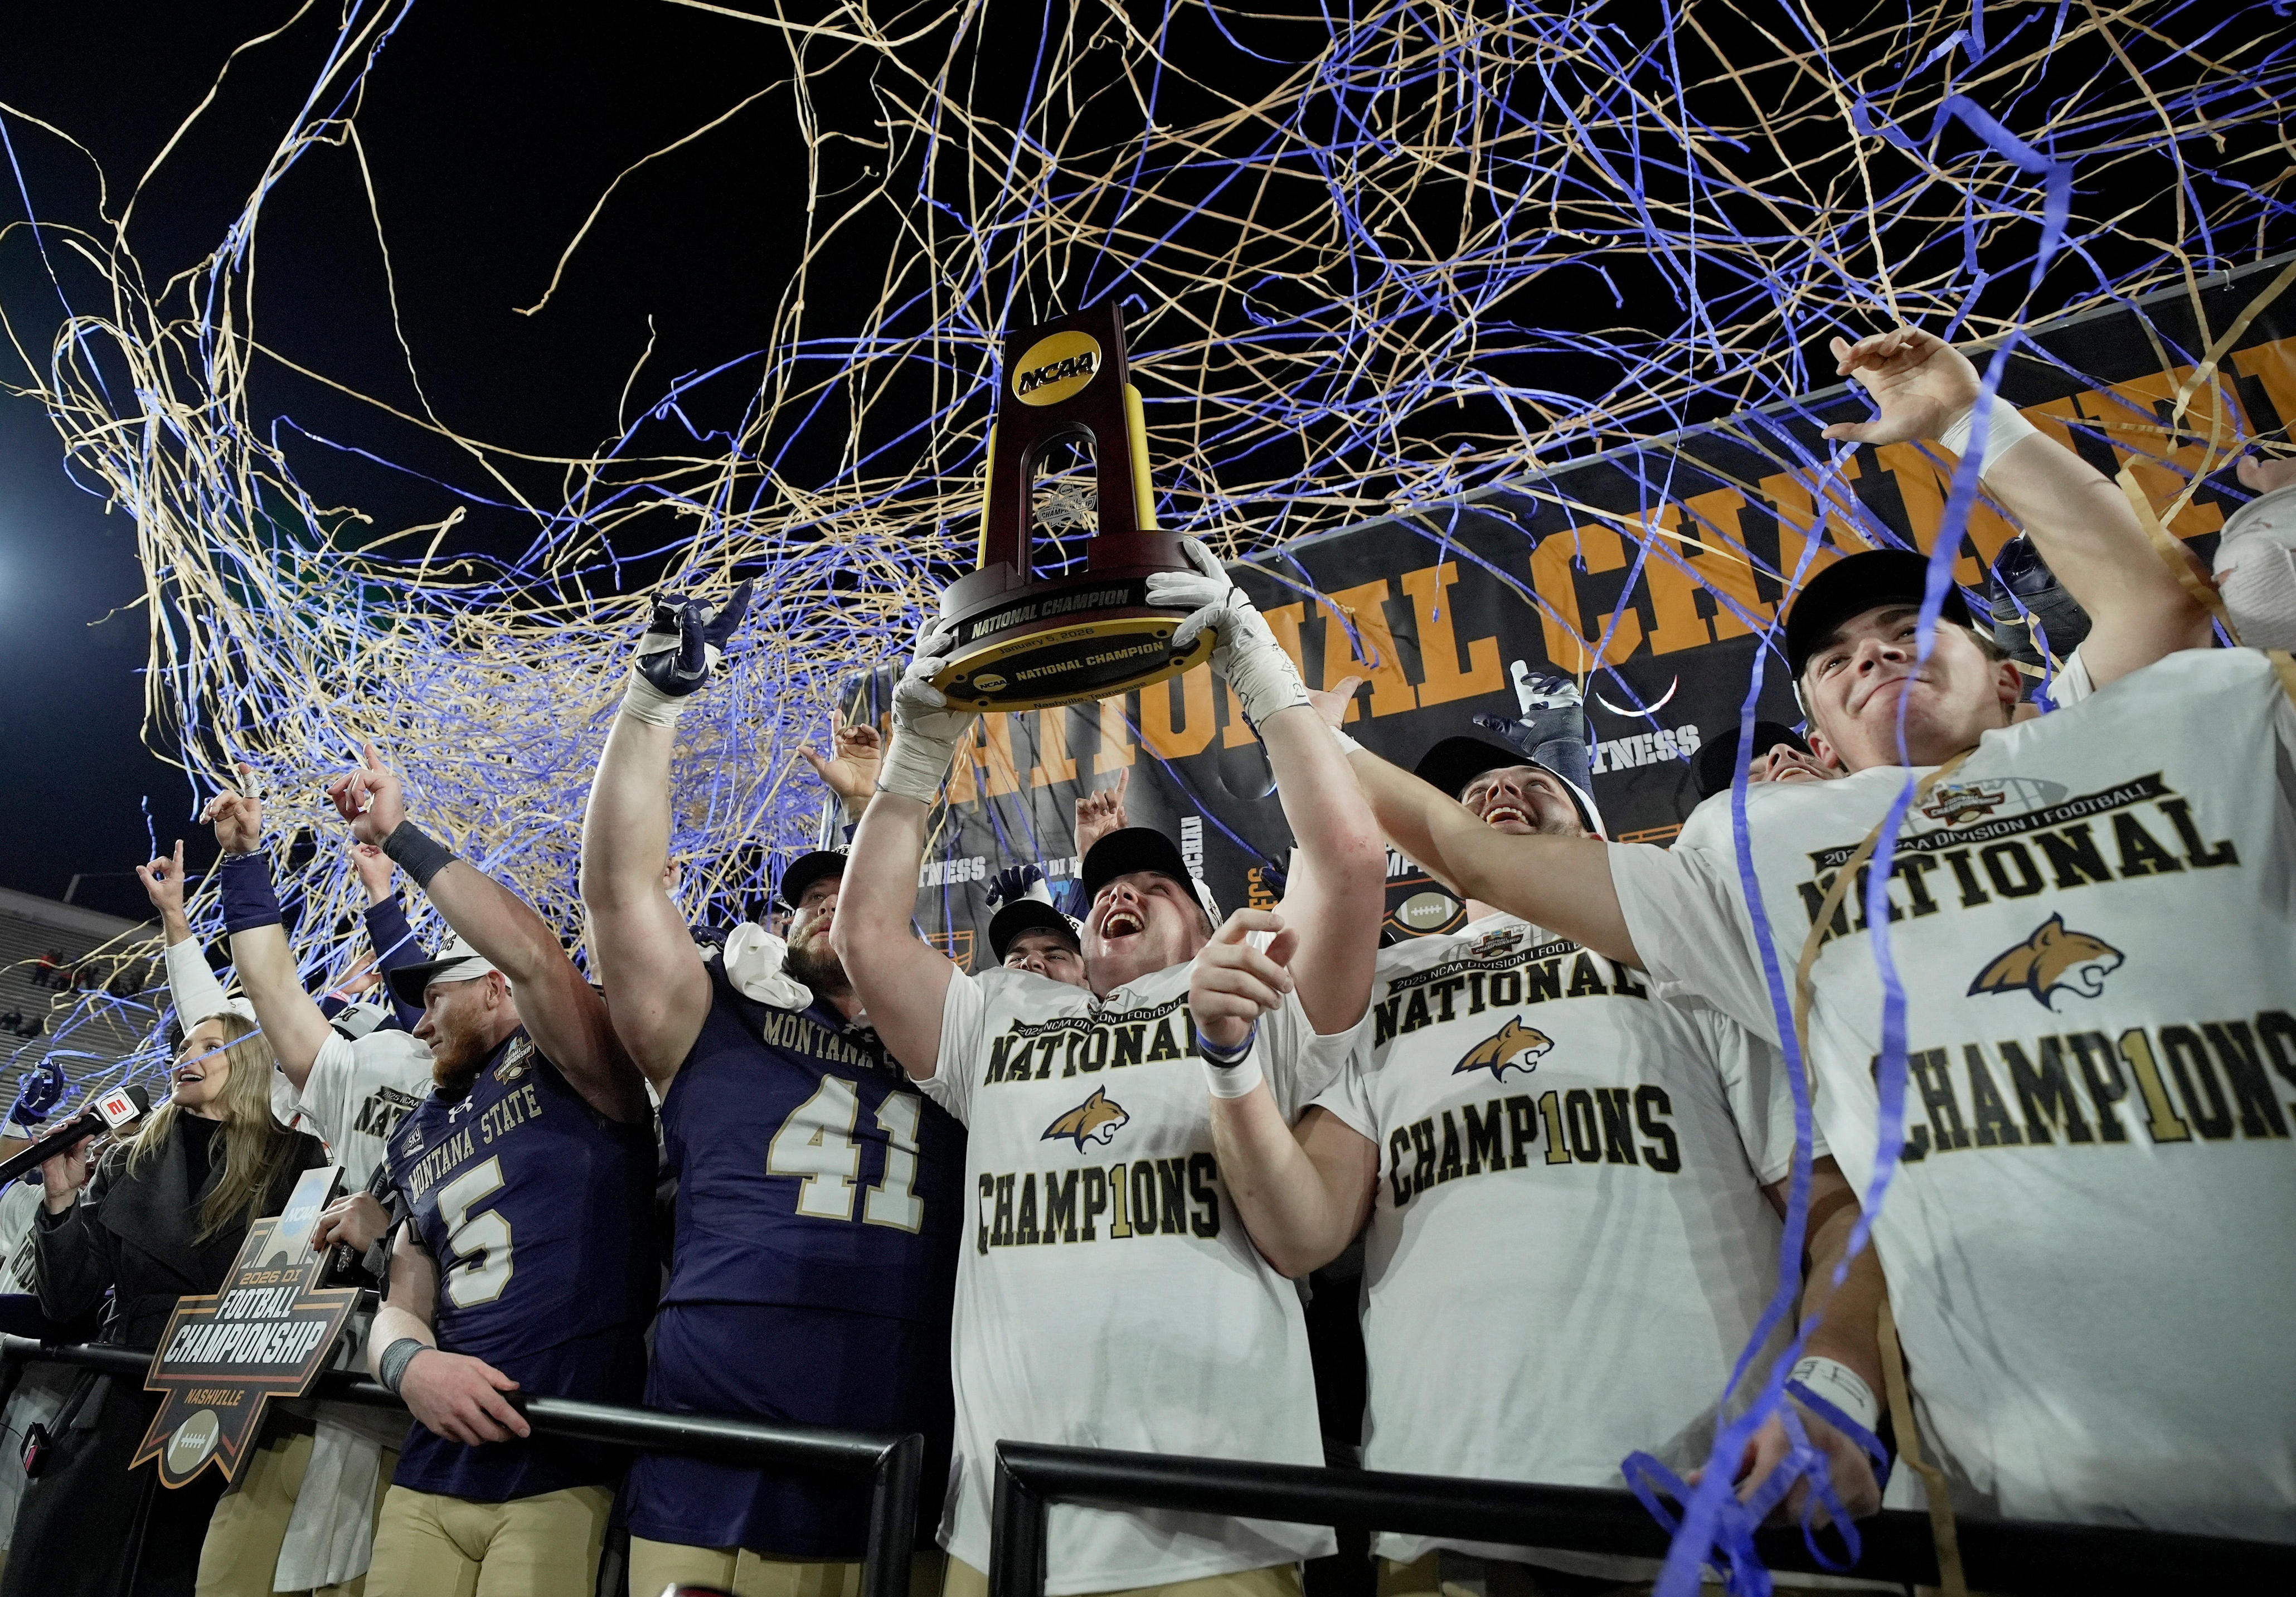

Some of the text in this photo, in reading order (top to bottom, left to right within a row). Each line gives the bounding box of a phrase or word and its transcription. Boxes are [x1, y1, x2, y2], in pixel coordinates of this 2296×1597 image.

[1017, 352, 1097, 395] NCAA
[972, 589, 1129, 639] NATIONAL CHAMPION
[999, 628, 1094, 654] January 5, 2026
[1016, 641, 1164, 681] NATIONAL CHAMPION
[979, 679, 1008, 690] NCAA
[1033, 681, 1147, 709] Nashville, Tennessee
[1585, 724, 1702, 775] TNESS
[1935, 817, 2026, 846] DIVISION
[2044, 783, 2152, 823] FOOTBALL
[918, 856, 986, 888] TNESS
[1475, 937, 1520, 953] CHAMPIONSHIP
[1396, 974, 1427, 989] 2025
[1431, 962, 1464, 979] NCAA
[1467, 953, 1526, 969] DIVISION
[1018, 1026, 1042, 1036] 2025
[1043, 1020, 1071, 1031] NCAA
[1127, 997, 1184, 1021] FOOTBALL
[1374, 951, 1648, 1050] NATIONAL
[764, 1011, 873, 1069] MONTANA
[498, 1045, 531, 1076] CHAMPIONSHIP
[382, 1090, 419, 1108] 2025 NCAA
[409, 1127, 474, 1204] MONTANA
[481, 1083, 542, 1144] STATE
[766, 1074, 924, 1234] 41
[285, 1205, 317, 1222] NCAA
[437, 1154, 514, 1309] 5
[240, 1269, 303, 1285] 2026 DI
[214, 1285, 300, 1320] FOOTBALL
[164, 1321, 327, 1363] CHAMPIONSHIP
[183, 1388, 245, 1406] NASHVILLE
